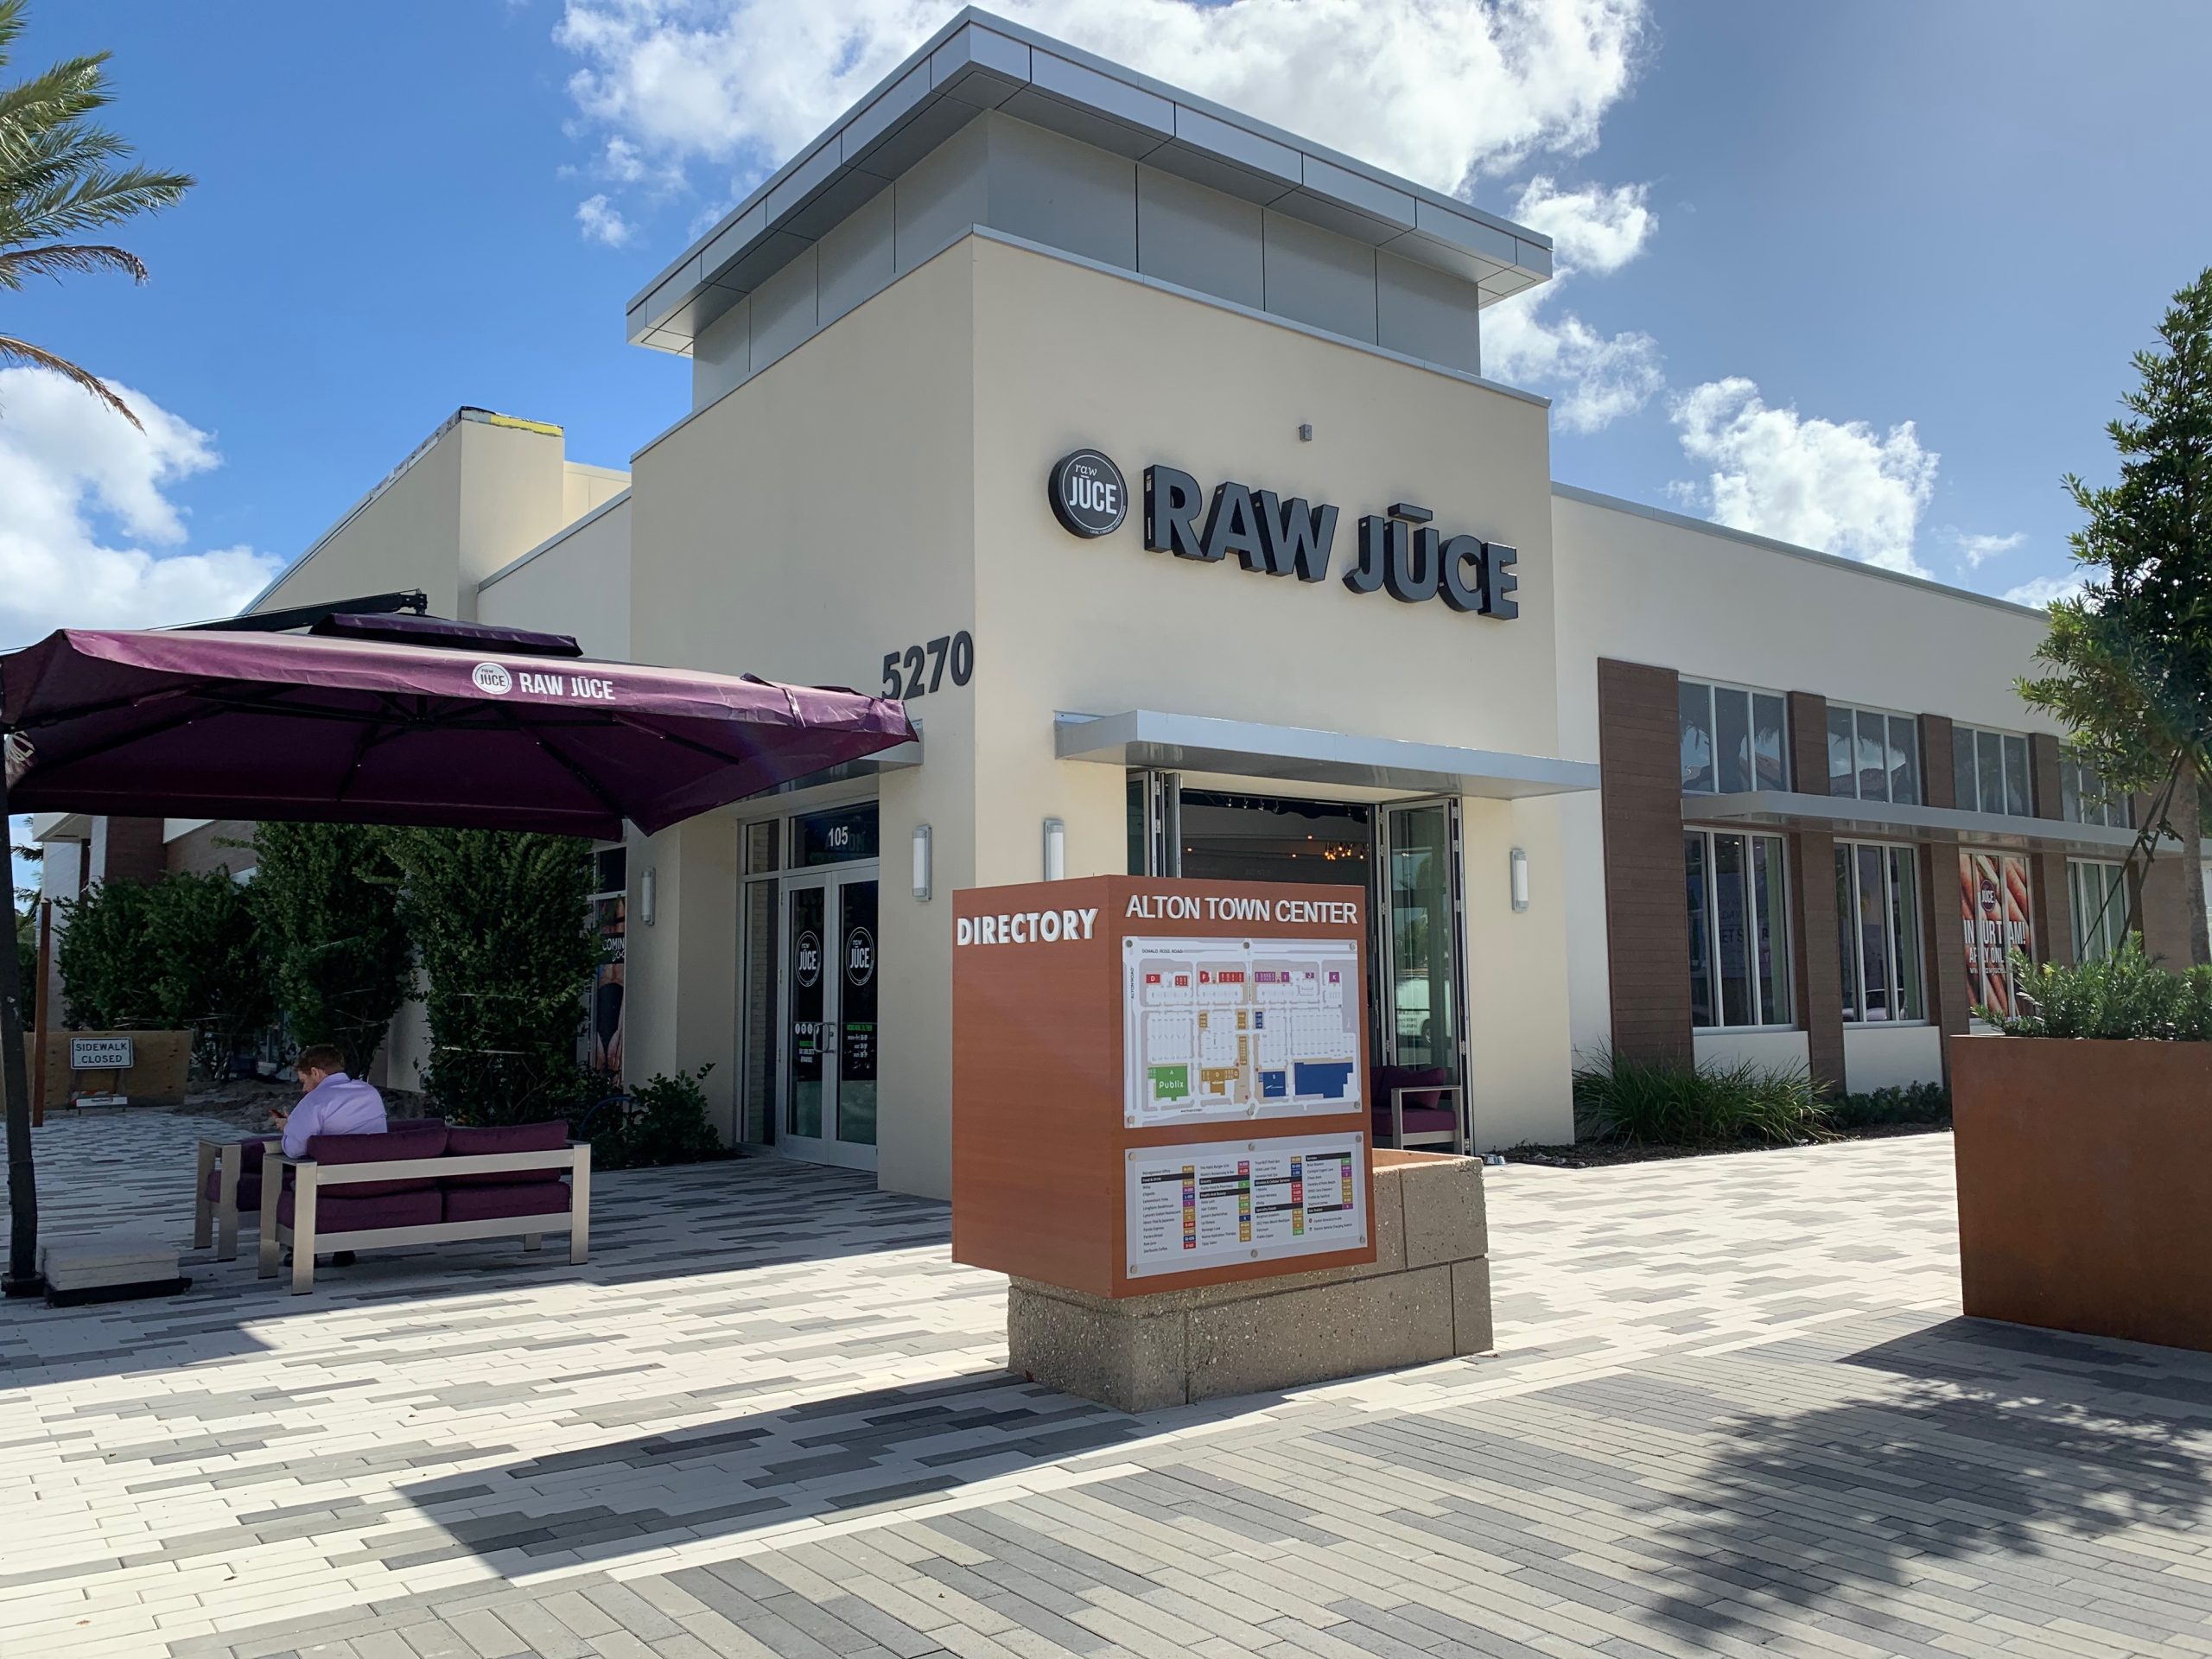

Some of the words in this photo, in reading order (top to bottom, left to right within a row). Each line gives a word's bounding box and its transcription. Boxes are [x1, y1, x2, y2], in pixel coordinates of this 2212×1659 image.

[1075, 464, 1097, 476] raw
[1143, 465, 1339, 583] RAW
[882, 631, 974, 700] 5270
[518, 672, 564, 696] RAW
[829, 825, 849, 848] 105
[1125, 895, 1200, 919] ALTON
[1205, 897, 1270, 922] TOWN
[1274, 900, 1358, 924] CENTER
[957, 908, 1099, 946] DIRECTORY
[1963, 920, 1975, 944] IN
[1984, 920, 1996, 944] UR
[1996, 920, 2026, 944] TAM!
[602, 937, 626, 951] COMIN
[75, 1042, 128, 1052] SIDEWALK
[81, 1054, 123, 1064] CLOSED
[1158, 1081, 1185, 1090] Publix
